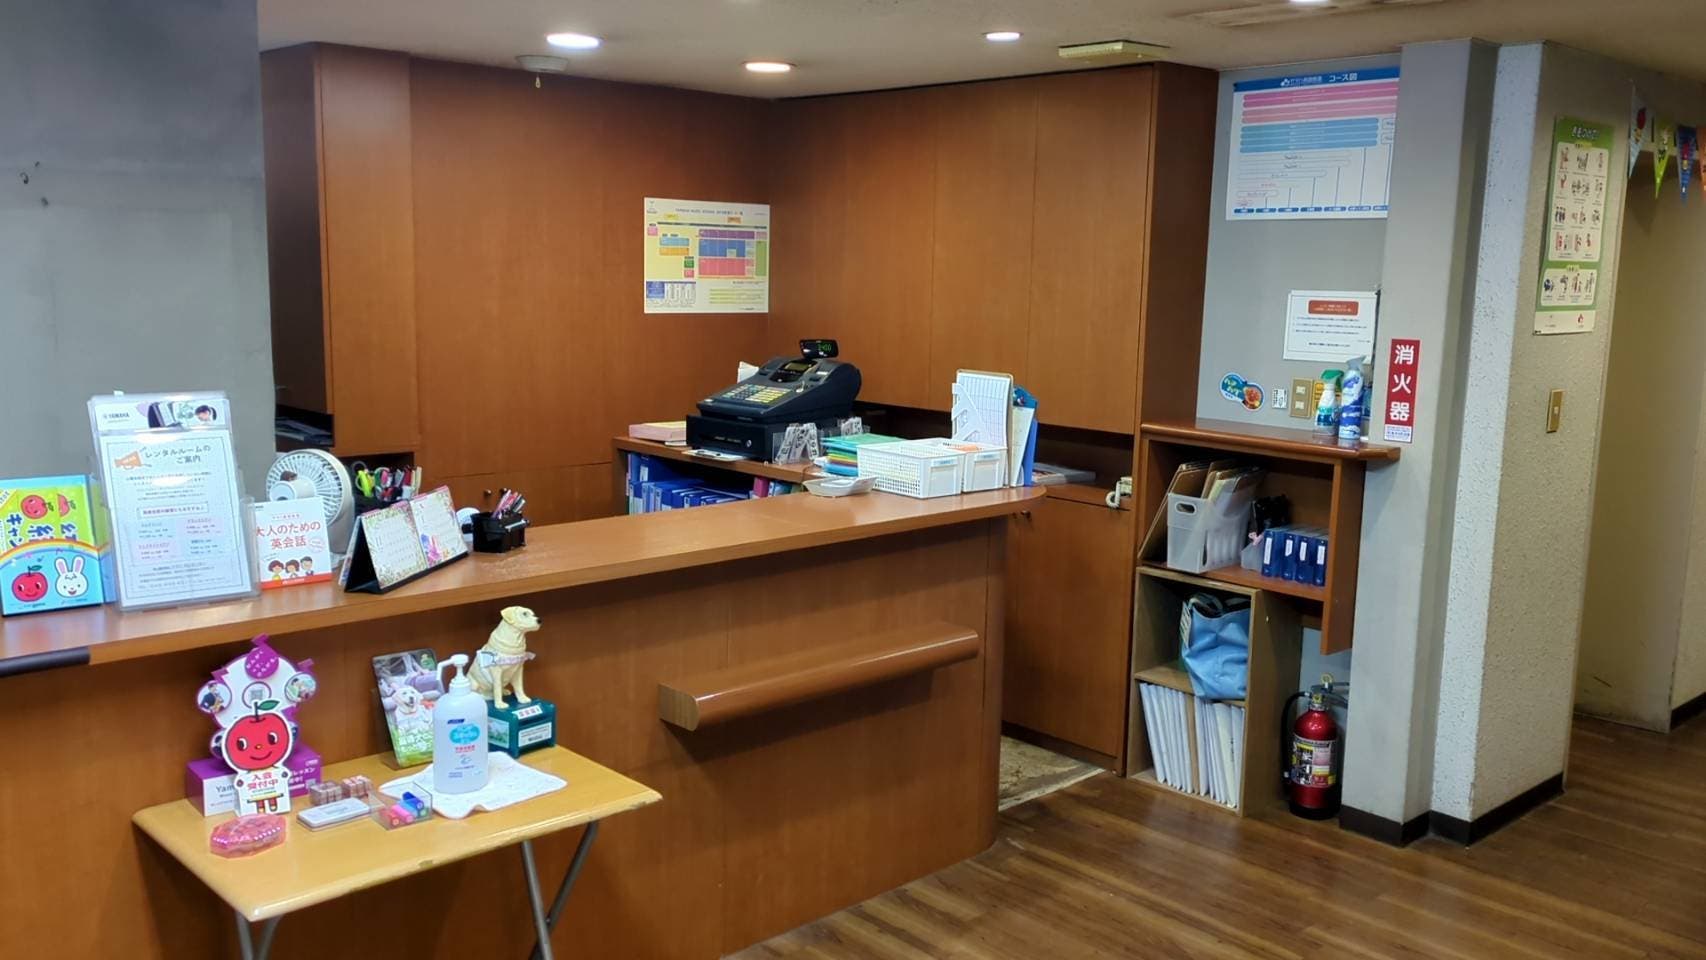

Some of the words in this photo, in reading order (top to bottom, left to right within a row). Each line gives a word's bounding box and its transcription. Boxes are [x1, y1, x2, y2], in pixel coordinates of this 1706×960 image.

[1389, 344, 1415, 421] 消火器
[145, 445, 211, 458] レンタルルームの
[176, 454, 201, 464] ご案内
[256, 521, 321, 537] 大人のための
[271, 535, 307, 550] 英会話
[247, 778, 279, 791] 受付中
